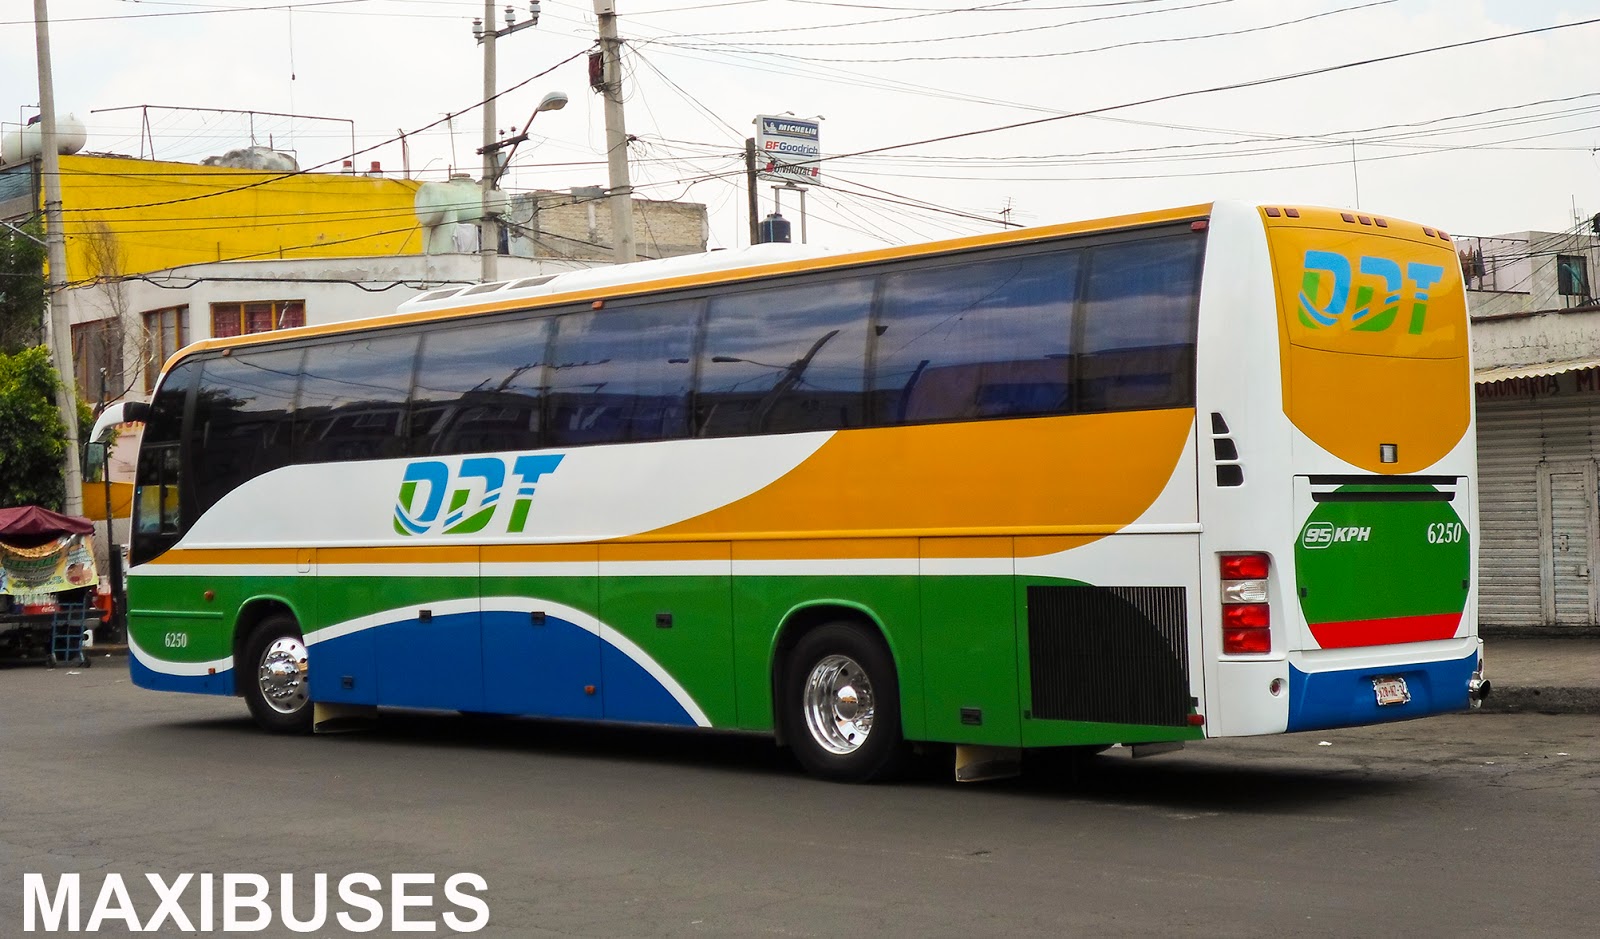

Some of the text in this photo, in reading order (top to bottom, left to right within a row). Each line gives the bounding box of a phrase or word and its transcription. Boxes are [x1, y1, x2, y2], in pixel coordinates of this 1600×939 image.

[778, 123, 817, 135] MICHELIN
[765, 140, 818, 154] BFGoodrich
[1304, 526, 1371, 543] 95 KPH
[1427, 522, 1462, 544] 6250
[164, 632, 187, 648] 6250
